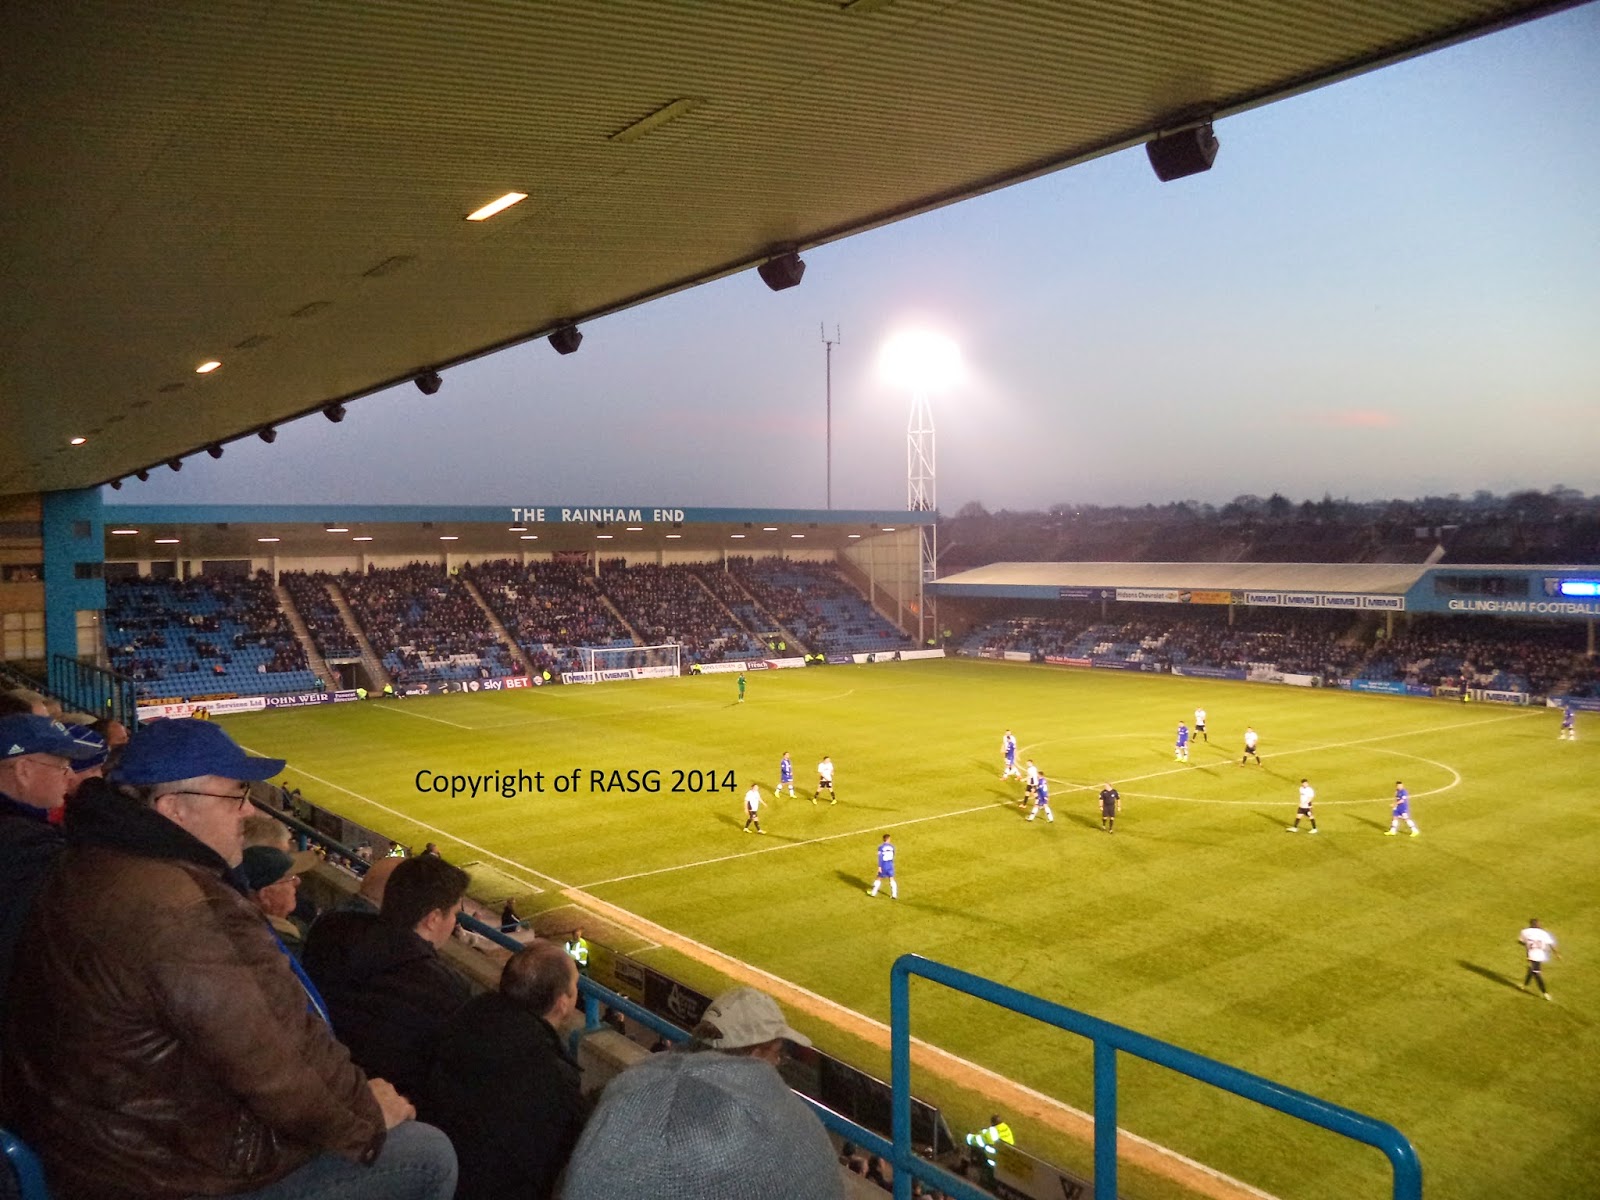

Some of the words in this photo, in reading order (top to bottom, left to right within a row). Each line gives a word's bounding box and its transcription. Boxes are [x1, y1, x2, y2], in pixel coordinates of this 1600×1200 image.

[511, 508, 545, 522] THE
[561, 508, 642, 522] RAINHAM
[653, 509, 684, 522] END
[1138, 591, 1165, 599] Chevrolet
[1288, 596, 1314, 604] MEMS
[1326, 597, 1355, 605] MEMS
[1367, 599, 1398, 607] MEMS
[1448, 599, 1526, 613] GILLINGHAM
[1529, 602, 1600, 615] FOOTBALL
[484, 679, 502, 690] sky
[506, 678, 529, 688] BET
[266, 696, 296, 705] JOHN
[299, 694, 329, 703] WEIR
